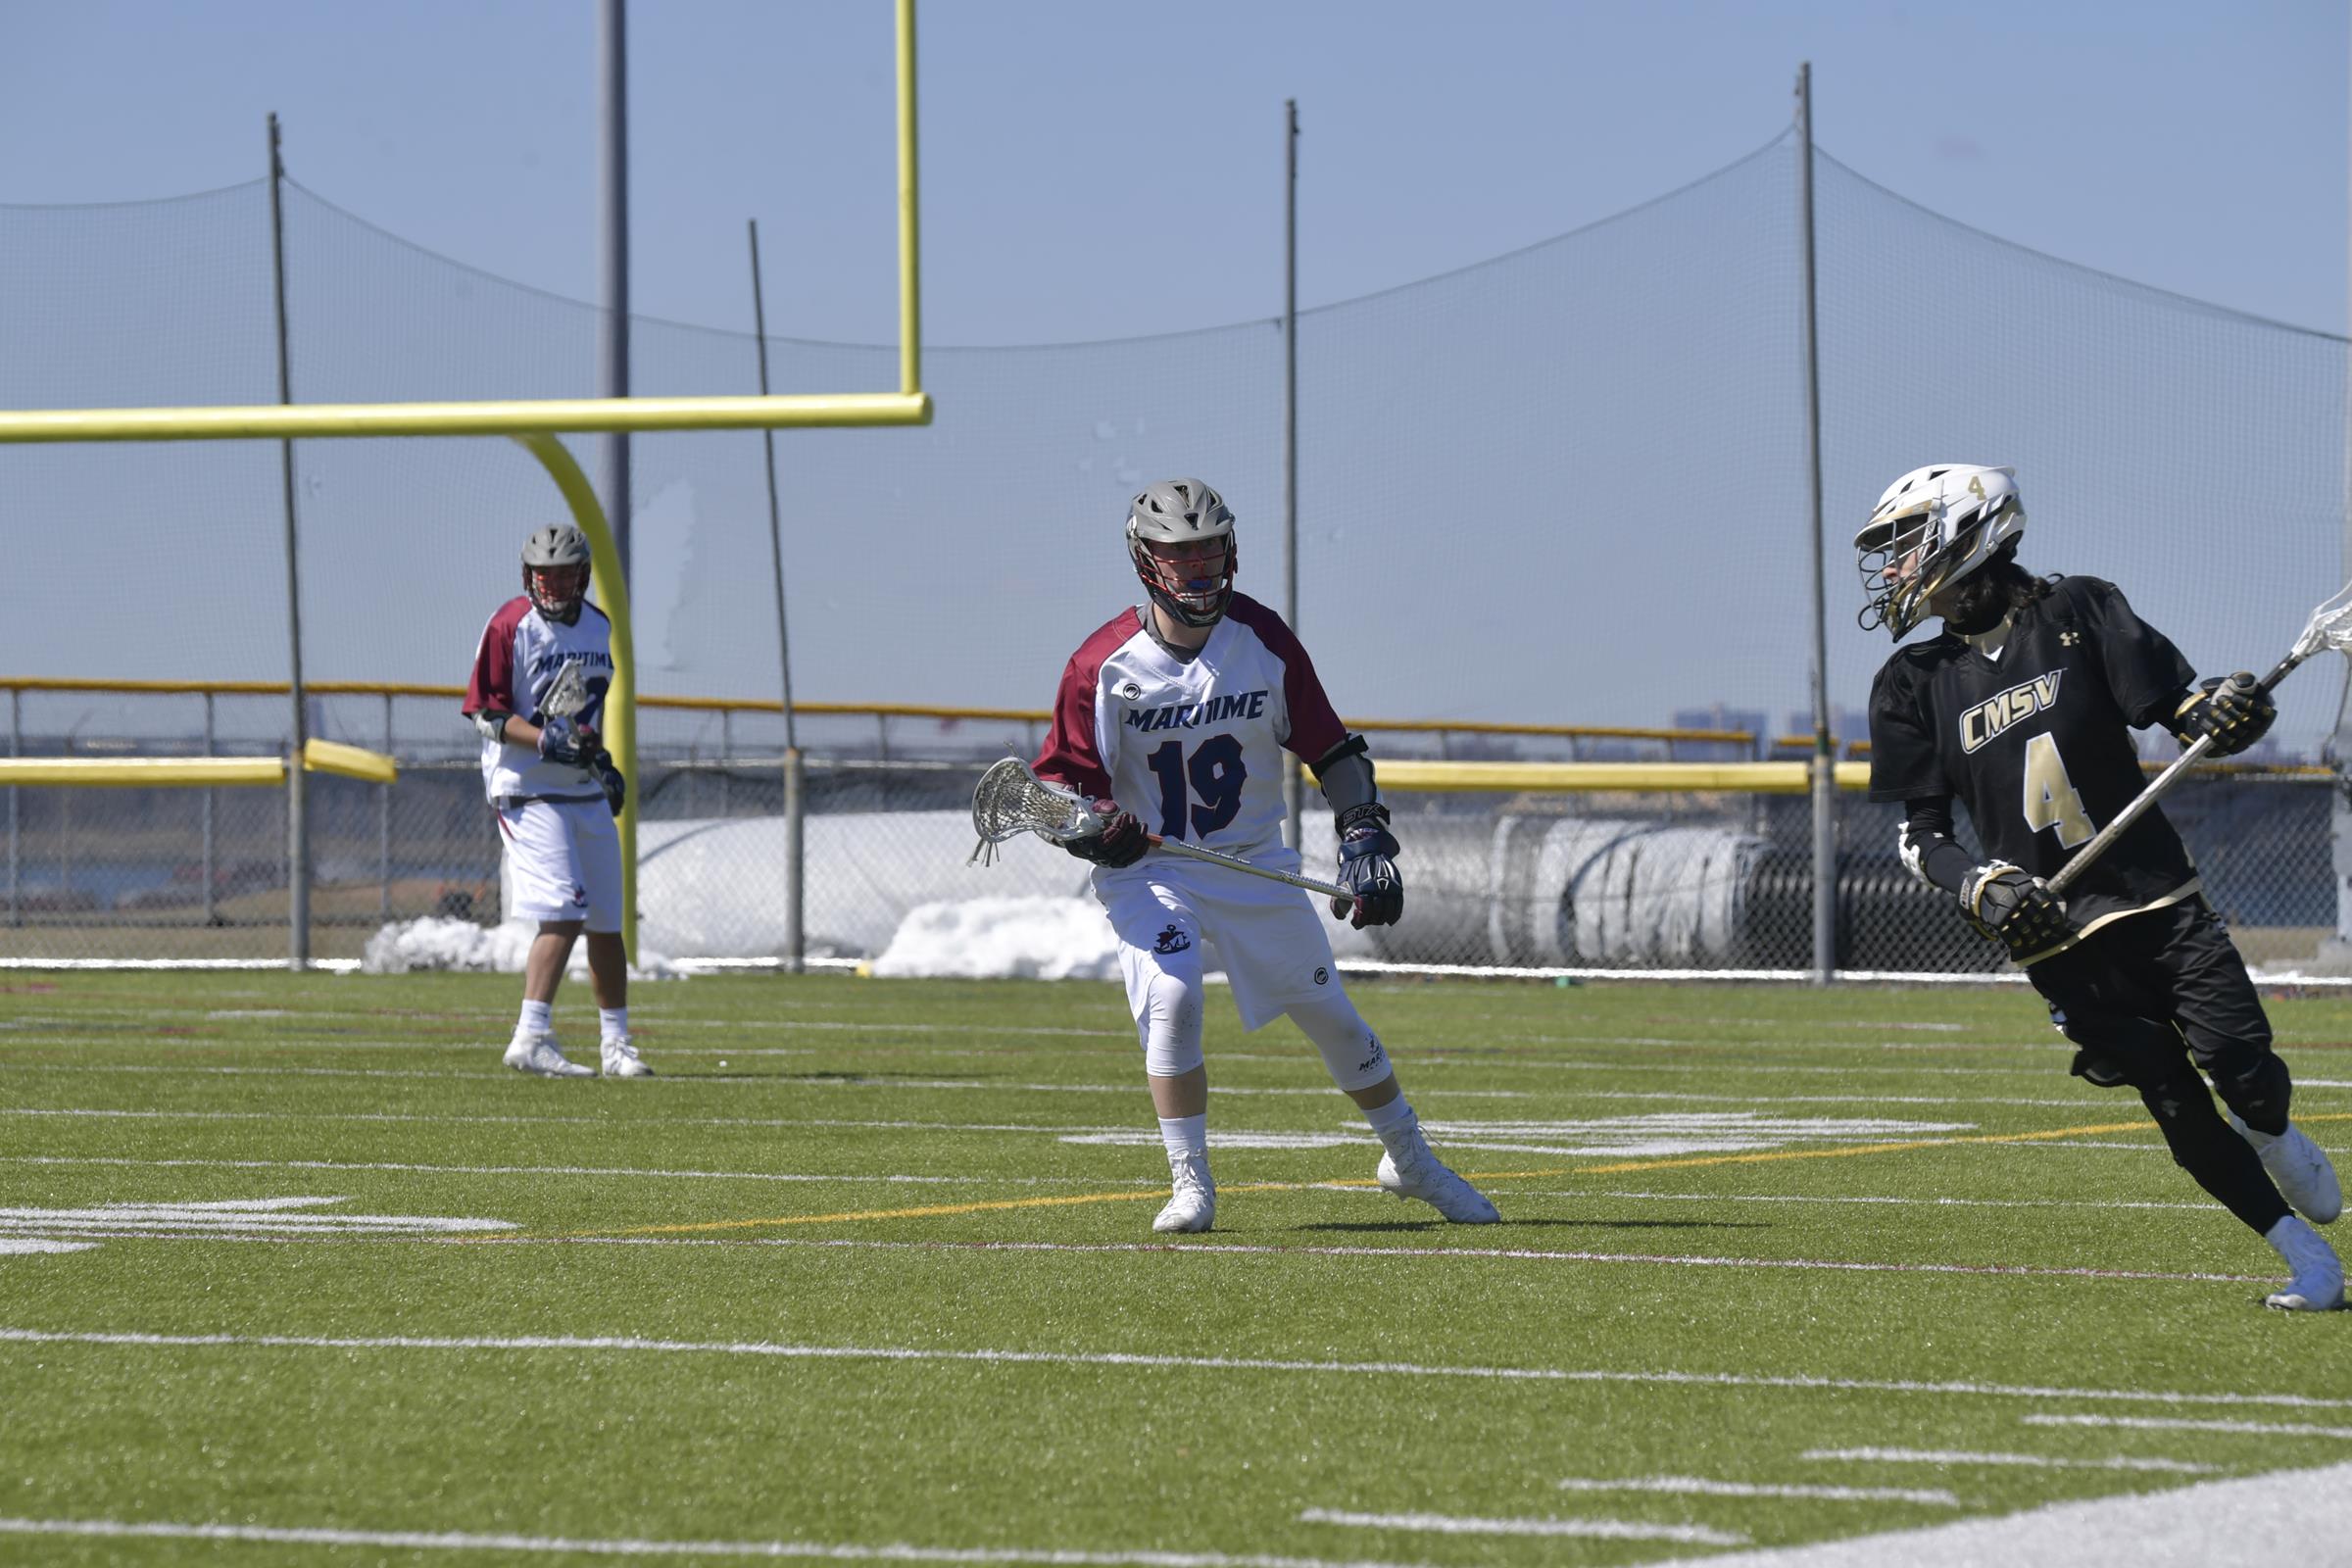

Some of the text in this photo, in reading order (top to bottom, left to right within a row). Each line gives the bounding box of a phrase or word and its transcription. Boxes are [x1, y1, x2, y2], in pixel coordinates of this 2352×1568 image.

[1968, 475, 1987, 501] 4
[1959, 668, 2063, 755] CMSV
[1147, 733, 1248, 842] 19
[2022, 731, 2098, 851] 4
